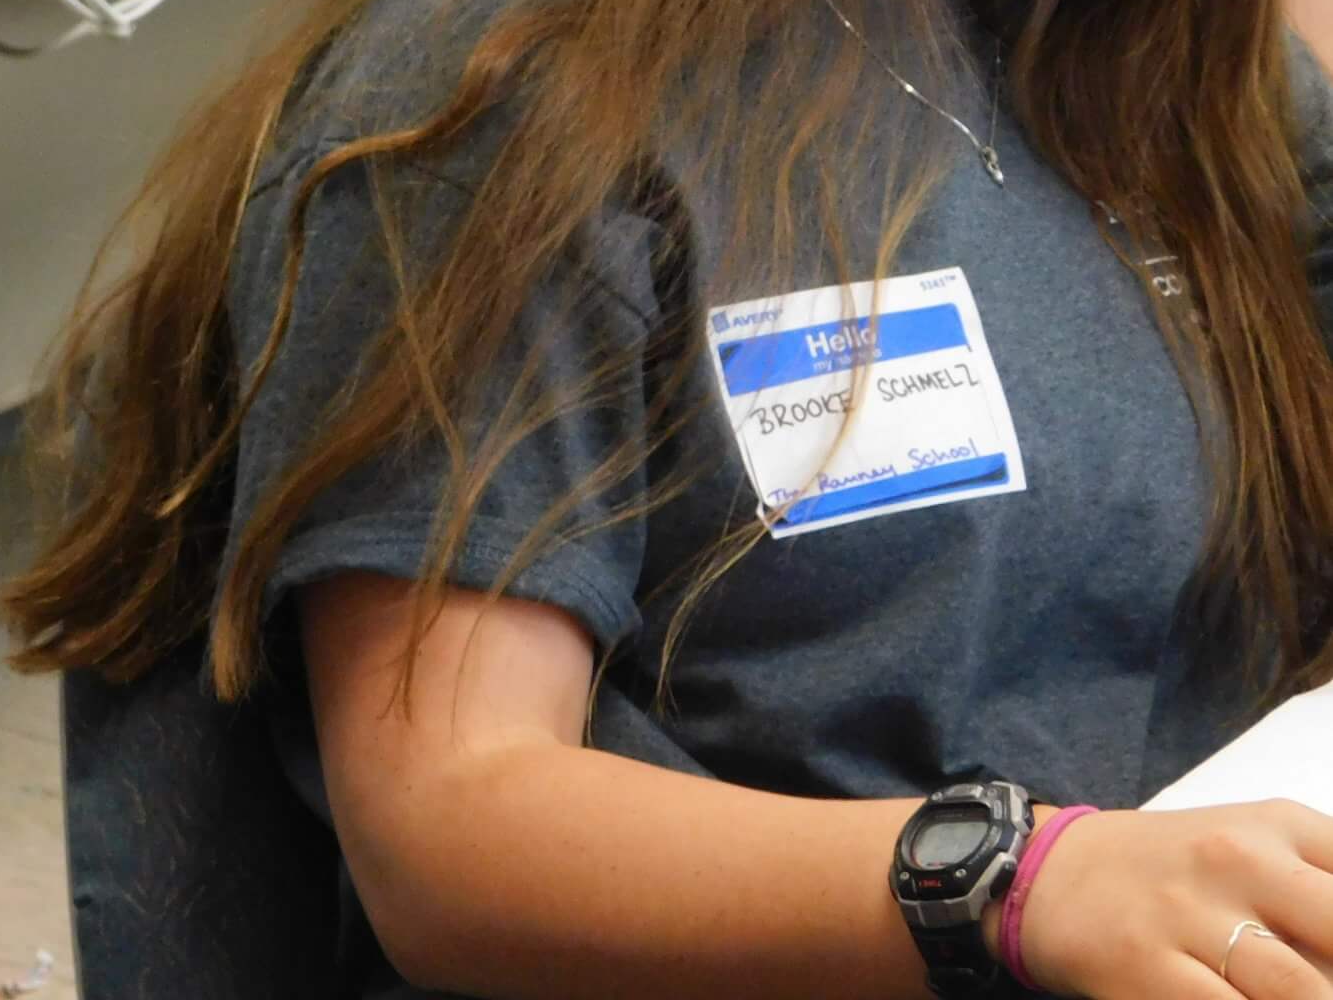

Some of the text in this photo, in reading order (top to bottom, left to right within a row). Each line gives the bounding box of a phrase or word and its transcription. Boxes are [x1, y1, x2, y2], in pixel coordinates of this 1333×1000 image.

[805, 324, 878, 359] Hello
[749, 362, 980, 436] BROOKE SCHMELZ
[907, 437, 980, 470] School
